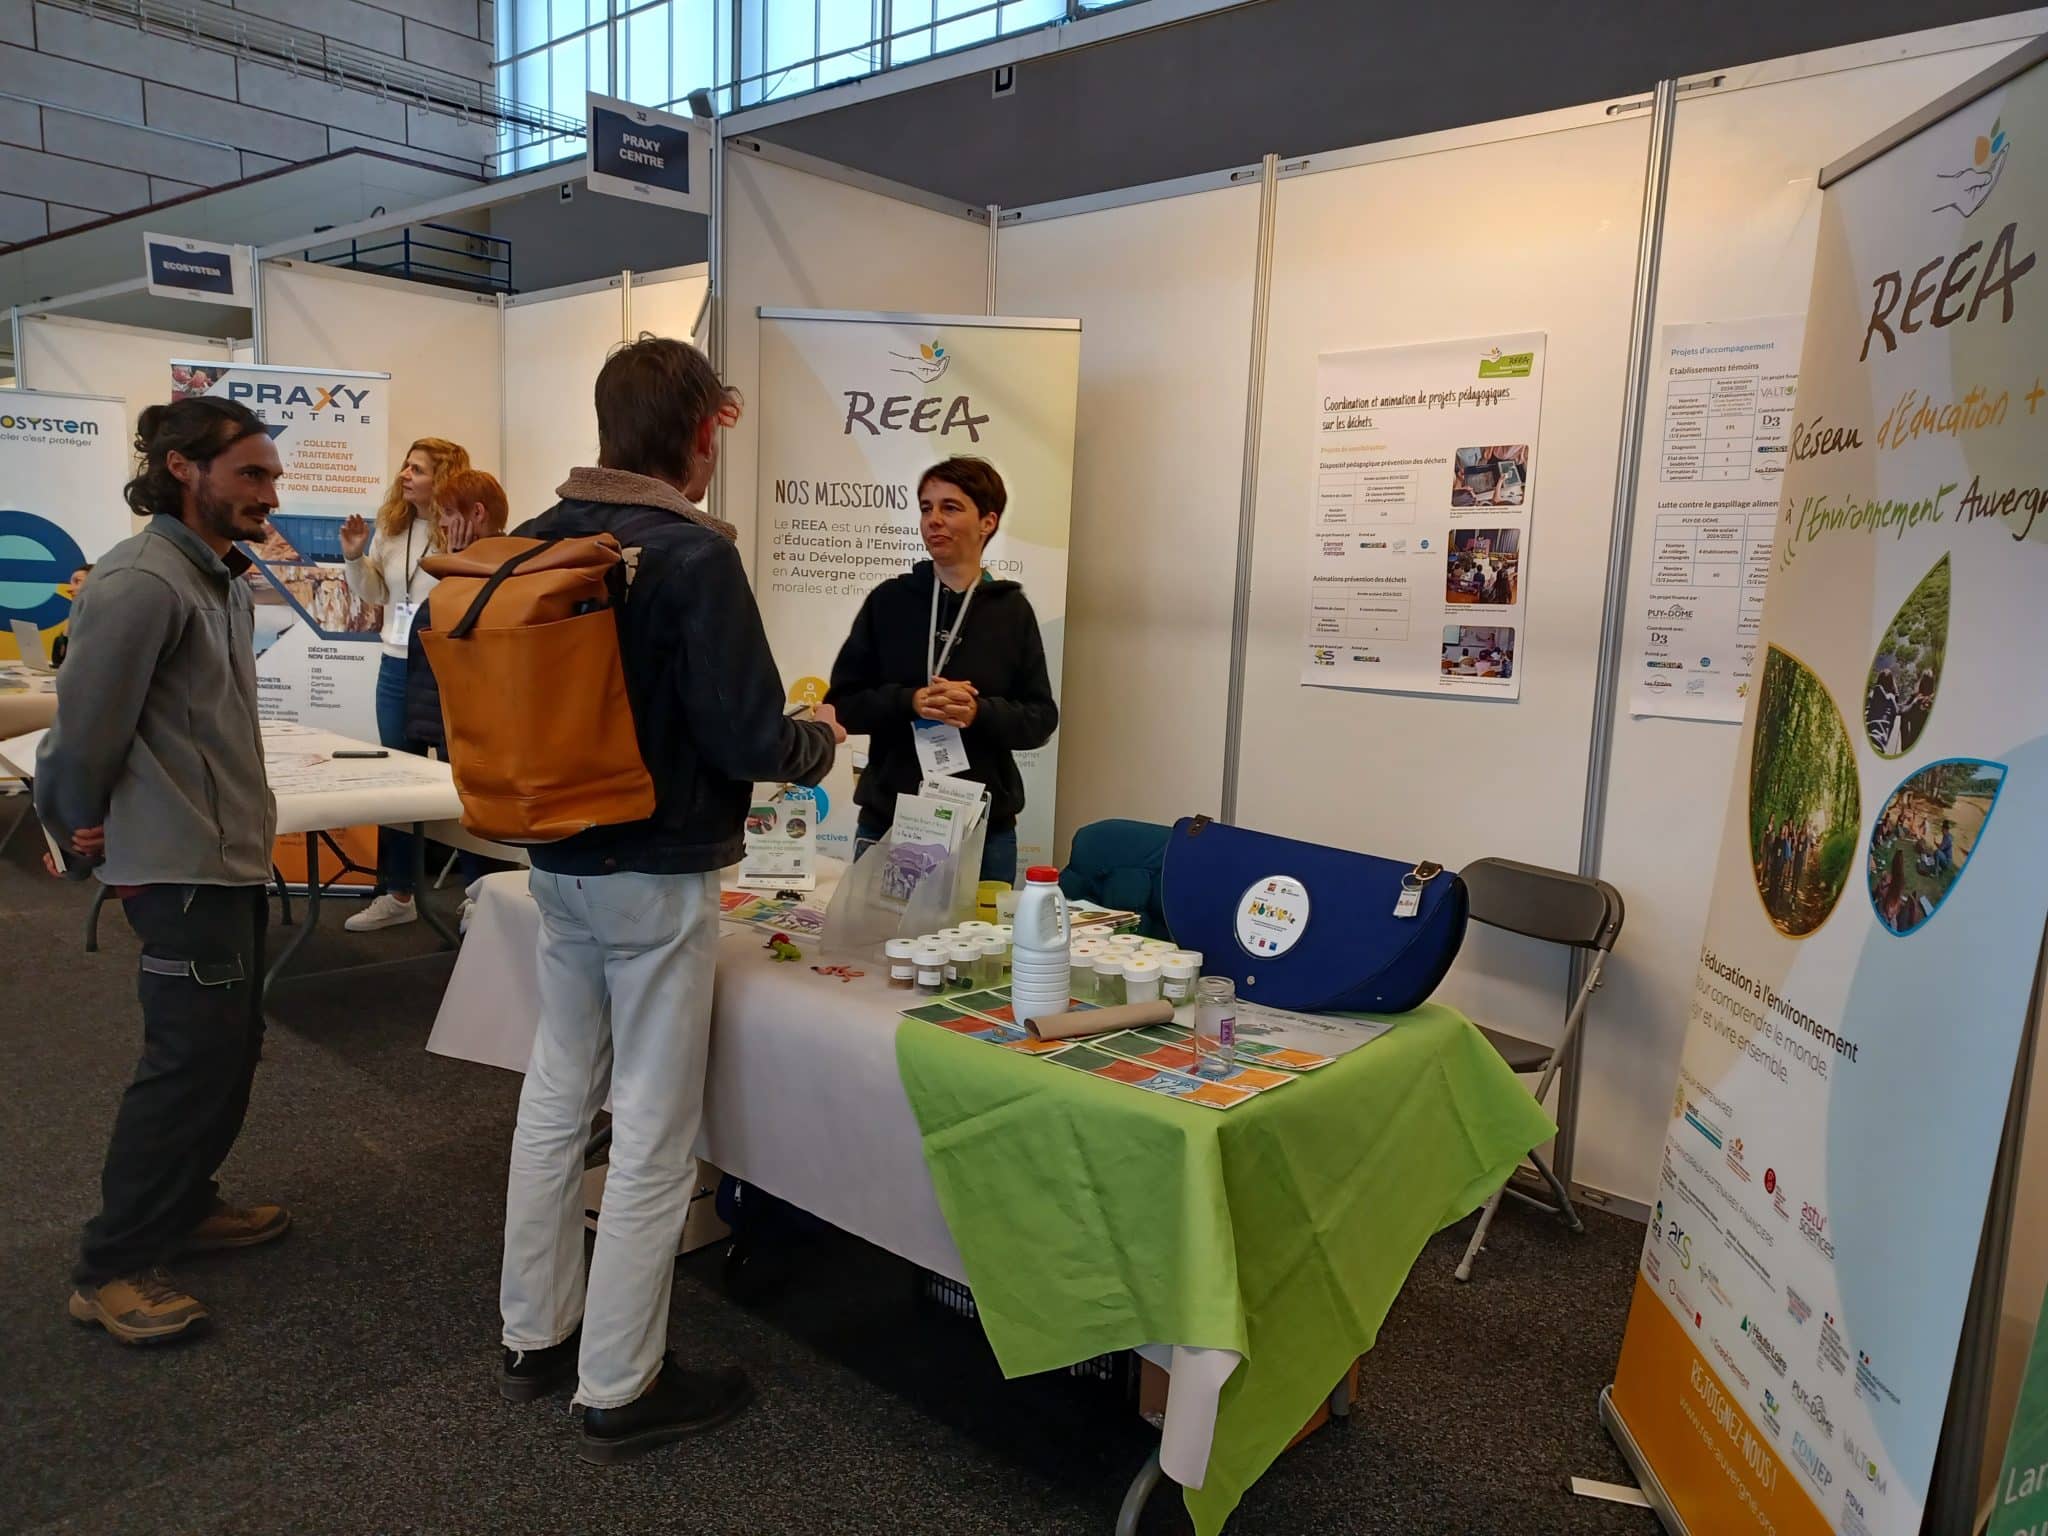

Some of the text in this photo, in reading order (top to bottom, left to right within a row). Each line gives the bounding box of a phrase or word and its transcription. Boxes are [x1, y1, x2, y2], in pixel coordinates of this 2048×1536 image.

[622, 133, 660, 153] PRAXY
[619, 148, 664, 168] CENTRE
[161, 260, 221, 278] ECOSYSTEM
[1859, 222, 2036, 363] REEA
[1671, 342, 1774, 356] Projets d'accompagnement
[1670, 362, 1760, 376] Etablissements témoins
[228, 381, 370, 412] PRAXY
[1324, 386, 1510, 412] Coordination et animation de projets pédagogiques
[256, 409, 370, 424] ENTRE
[844, 390, 990, 442] REEA
[1322, 415, 1372, 430] sur les déchets
[1762, 414, 1781, 427] D3
[22, 434, 46, 442] c'est
[48, 436, 92, 446] protéger
[303, 439, 348, 450] COLLECTE
[1789, 416, 1864, 465] Réseau
[297, 450, 353, 461] TRAITEMENT
[293, 461, 357, 472] VALORISATION
[1346, 460, 1380, 469] pédagogique
[1381, 459, 1412, 468] prévention
[325, 474, 380, 484] DANGEREUX
[288, 483, 308, 492] NON
[311, 484, 367, 494] DANGEREUX
[775, 479, 908, 510] NOS MISSIONS
[1658, 500, 1778, 510] Lutte contre le gaspillage alimen
[1954, 475, 2048, 542] Auvergn
[774, 518, 919, 536] Le REEA est un réseau
[773, 534, 852, 549] d'Éducation
[856, 537, 863, 549] à
[773, 552, 916, 570] et au Développement
[772, 567, 856, 580] en Auvergne
[1384, 576, 1407, 584] déchets
[772, 582, 822, 594] morales
[825, 583, 838, 595] et
[1651, 632, 1668, 644] D3
[816, 833, 848, 842] ectives
[1696, 974, 1710, 995] our
[1712, 986, 1773, 1039] comprendre
[1774, 1026, 1784, 1047] le
[1703, 1011, 1713, 1029] et
[1714, 1018, 1737, 1044] vivre
[1754, 980, 1762, 1000] à
[1762, 984, 1859, 1064] l'environnement
[1792, 1431, 1833, 1487] FONJEP
